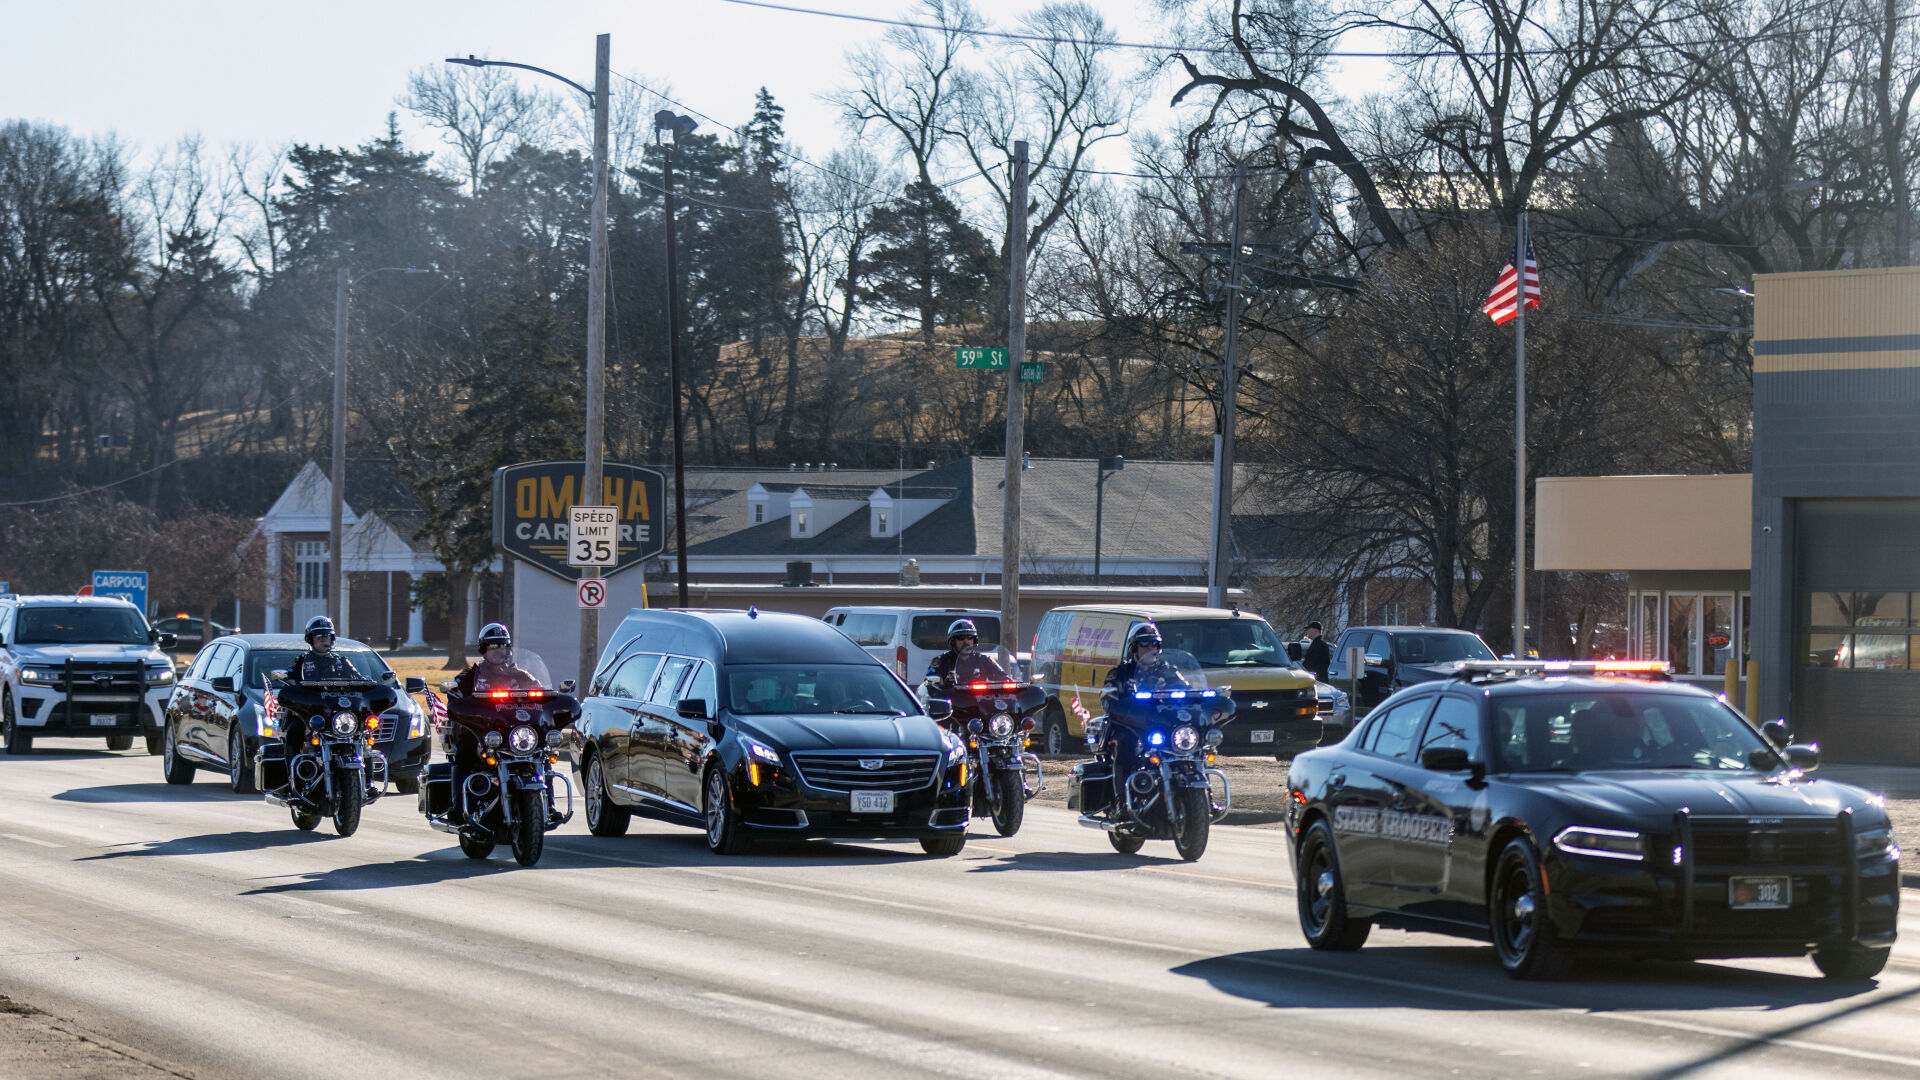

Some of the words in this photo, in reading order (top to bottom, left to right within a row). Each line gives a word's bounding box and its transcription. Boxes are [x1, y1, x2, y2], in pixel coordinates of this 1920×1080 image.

[962, 350, 983, 366] 59th
[991, 350, 1003, 366] St
[516, 475, 650, 520] OMHA
[574, 512, 614, 523] SPEED
[515, 523, 569, 541] CAR
[577, 526, 609, 536] LIMIT
[575, 540, 611, 562] 35
[95, 575, 145, 590] CARPOOL
[1075, 627, 1115, 648] DHL
[1334, 806, 1378, 836] STATE
[1380, 809, 1451, 846] TROOPER
[1758, 884, 1780, 902] 302
